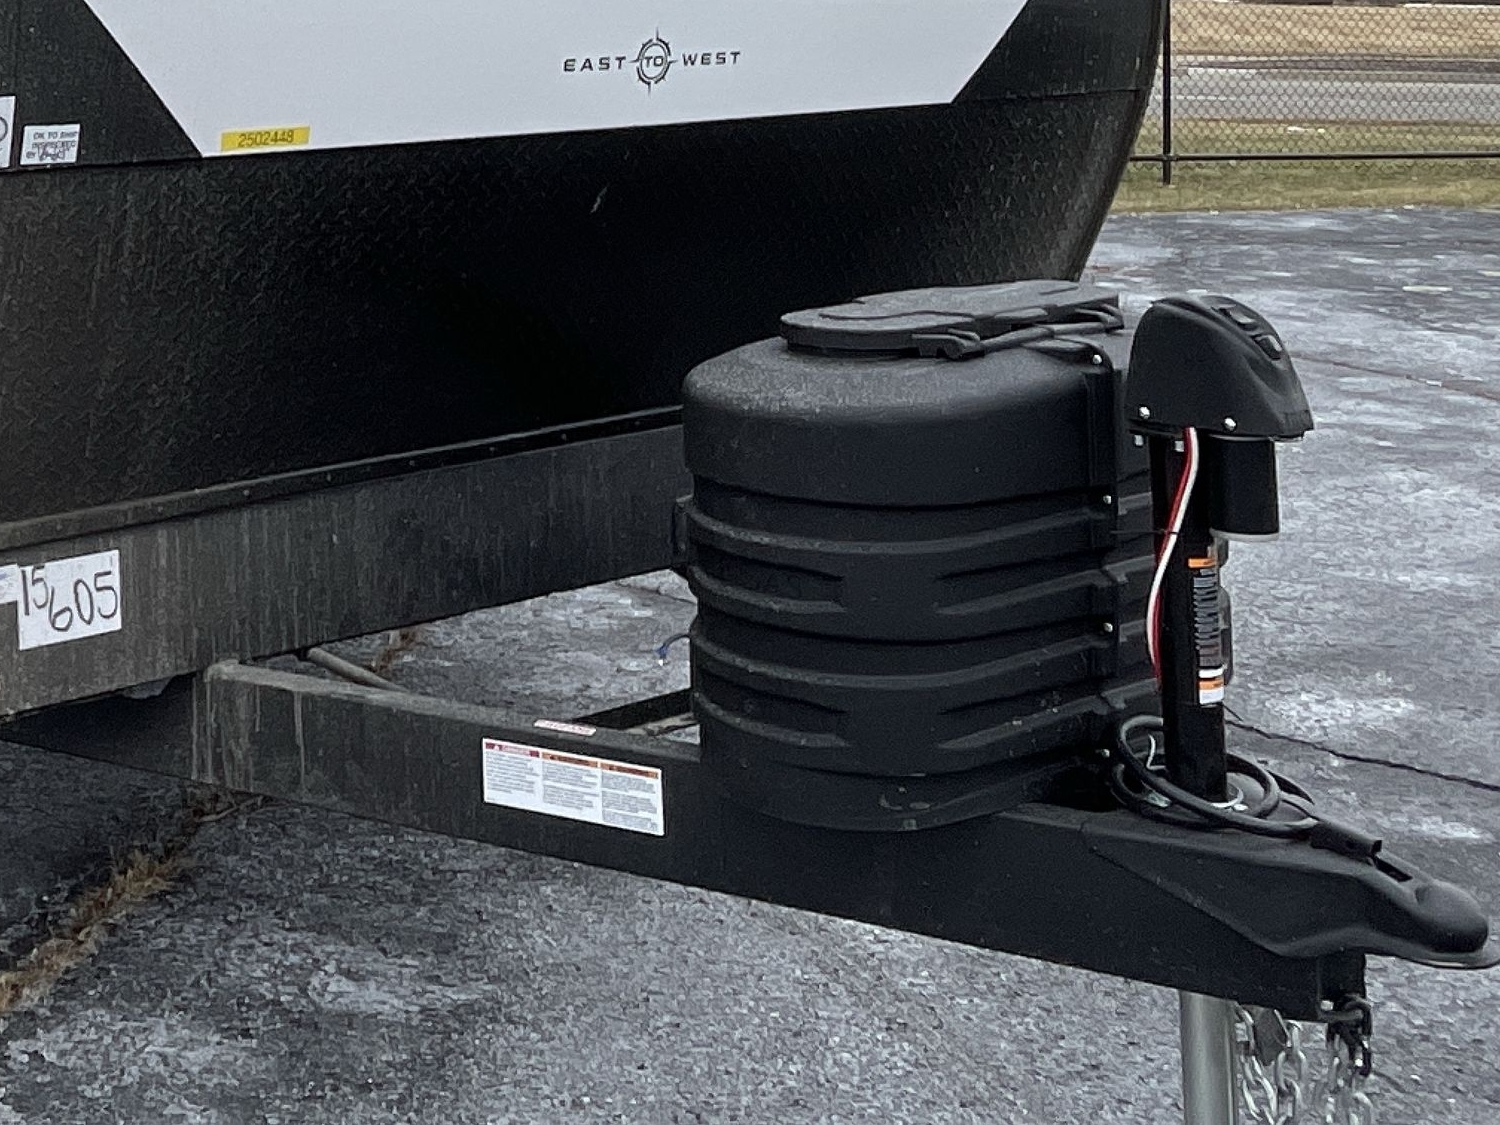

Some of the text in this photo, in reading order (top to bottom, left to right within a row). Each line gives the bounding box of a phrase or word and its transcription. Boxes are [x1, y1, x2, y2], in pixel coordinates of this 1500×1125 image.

[563, 51, 741, 73] EAST TO WEST
